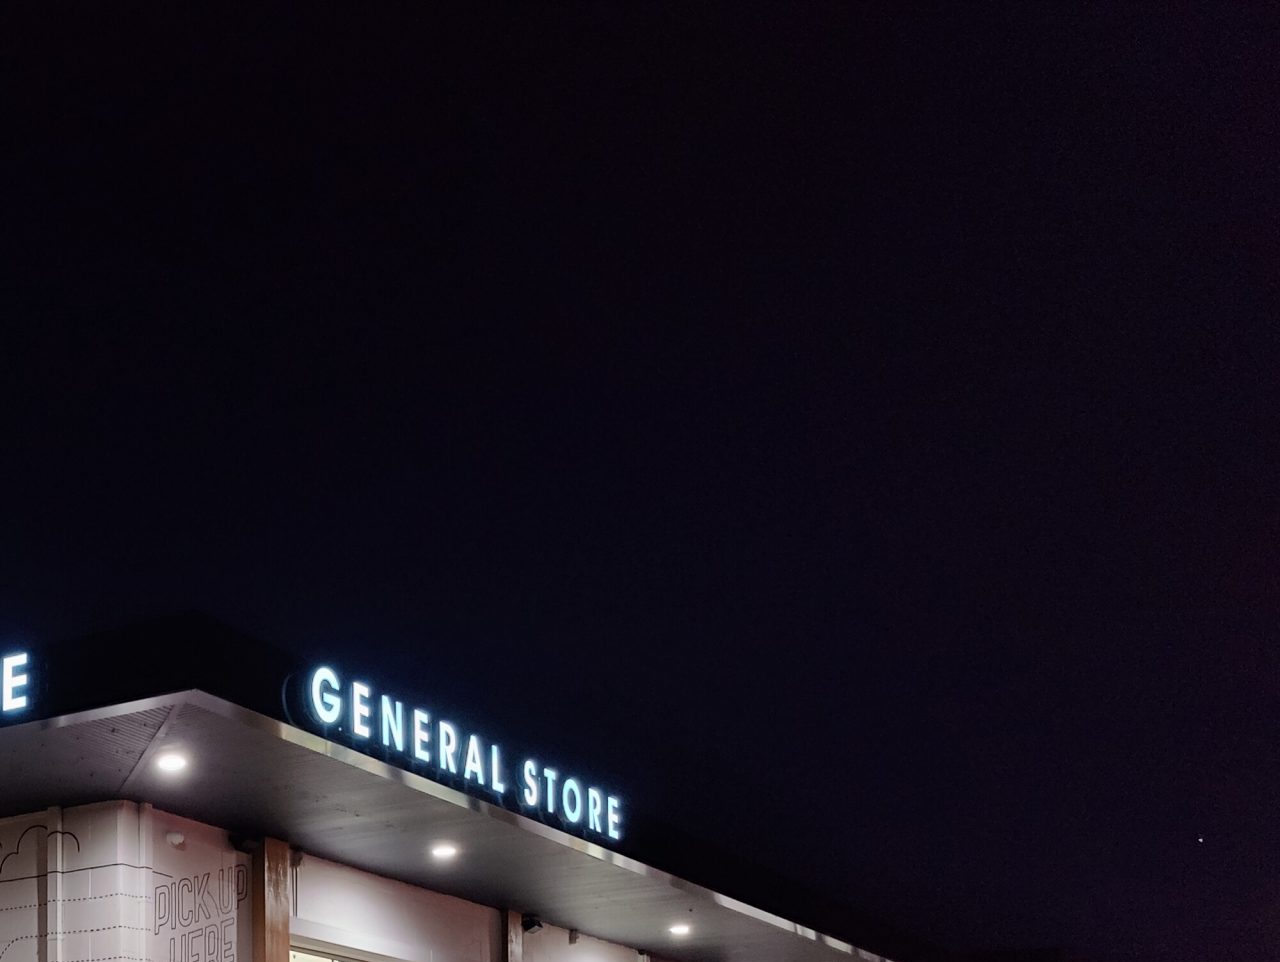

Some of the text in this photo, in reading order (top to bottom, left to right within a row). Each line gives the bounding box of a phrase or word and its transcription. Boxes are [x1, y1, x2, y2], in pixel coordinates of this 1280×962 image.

[311, 666, 620, 840] GENERAL STORE
[154, 863, 248, 936] PICK UP
